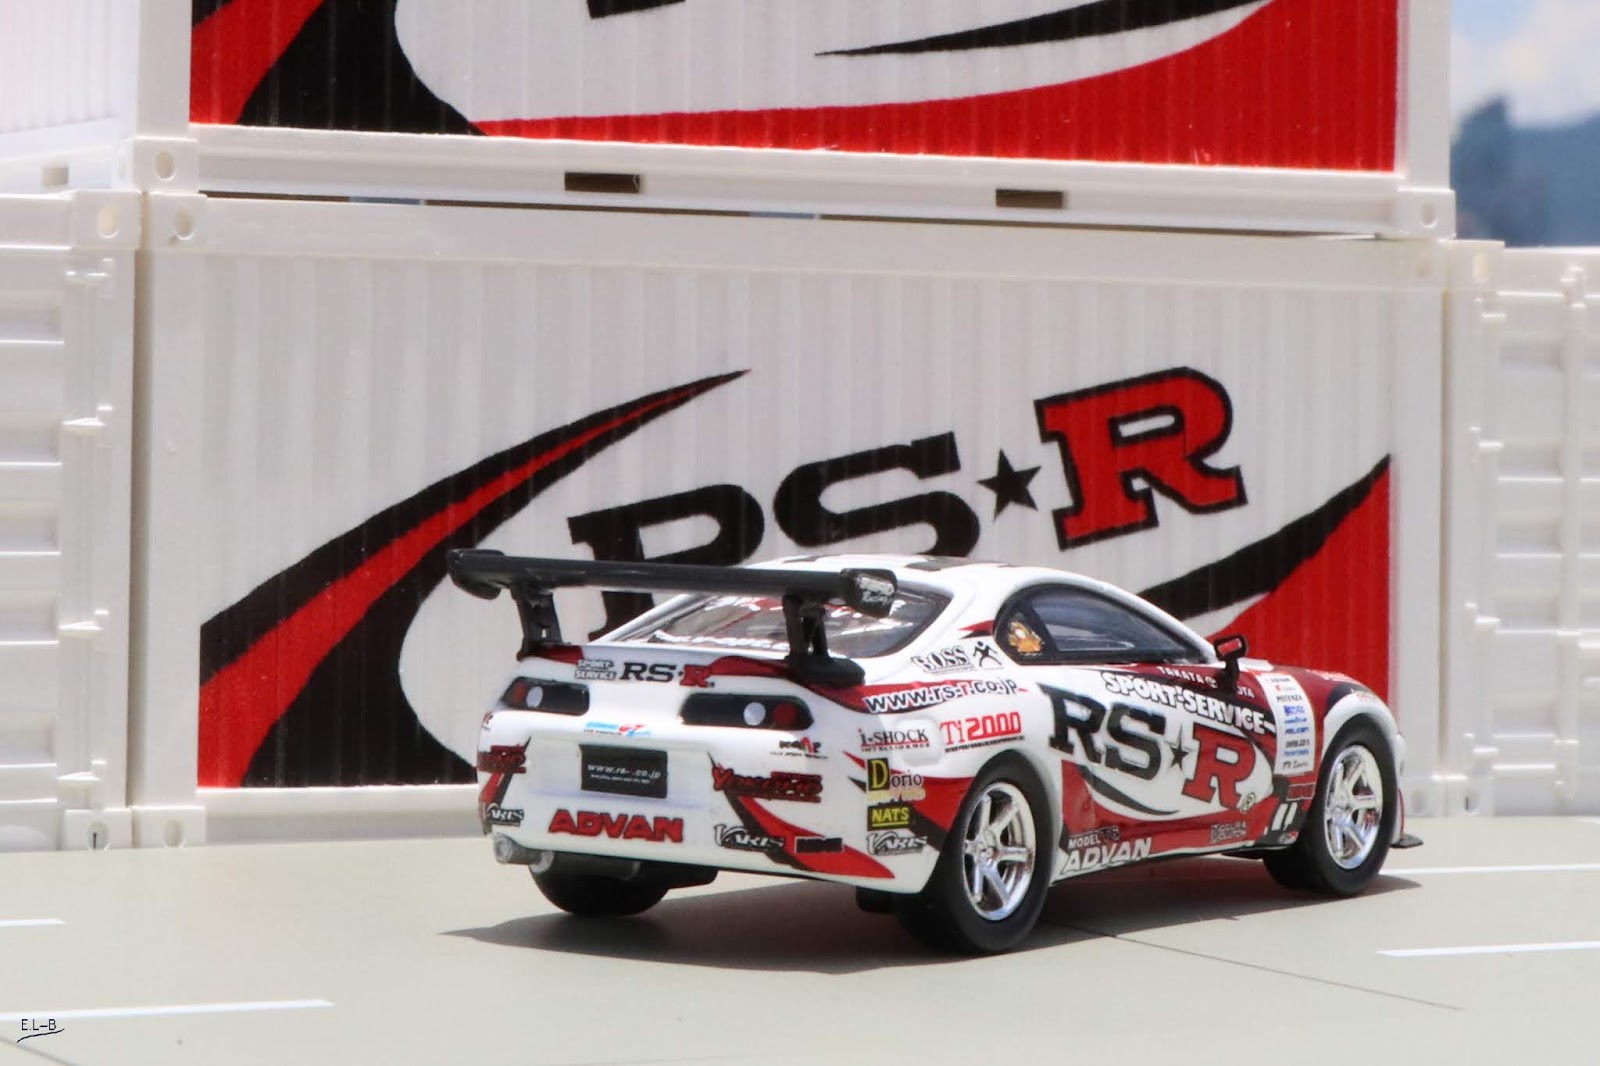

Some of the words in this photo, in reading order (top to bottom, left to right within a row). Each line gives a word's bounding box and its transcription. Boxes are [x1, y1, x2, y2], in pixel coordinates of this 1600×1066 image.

[911, 645, 974, 671] BOSS
[575, 669, 617, 681] SERVICE
[1156, 665, 1205, 685] TAKATA
[867, 758, 923, 791] Dorio
[548, 808, 684, 844] ADVAN
[871, 806, 910, 823] NATS
[1068, 834, 1101, 849] MODEL
[1061, 837, 1152, 875] ADVAN
